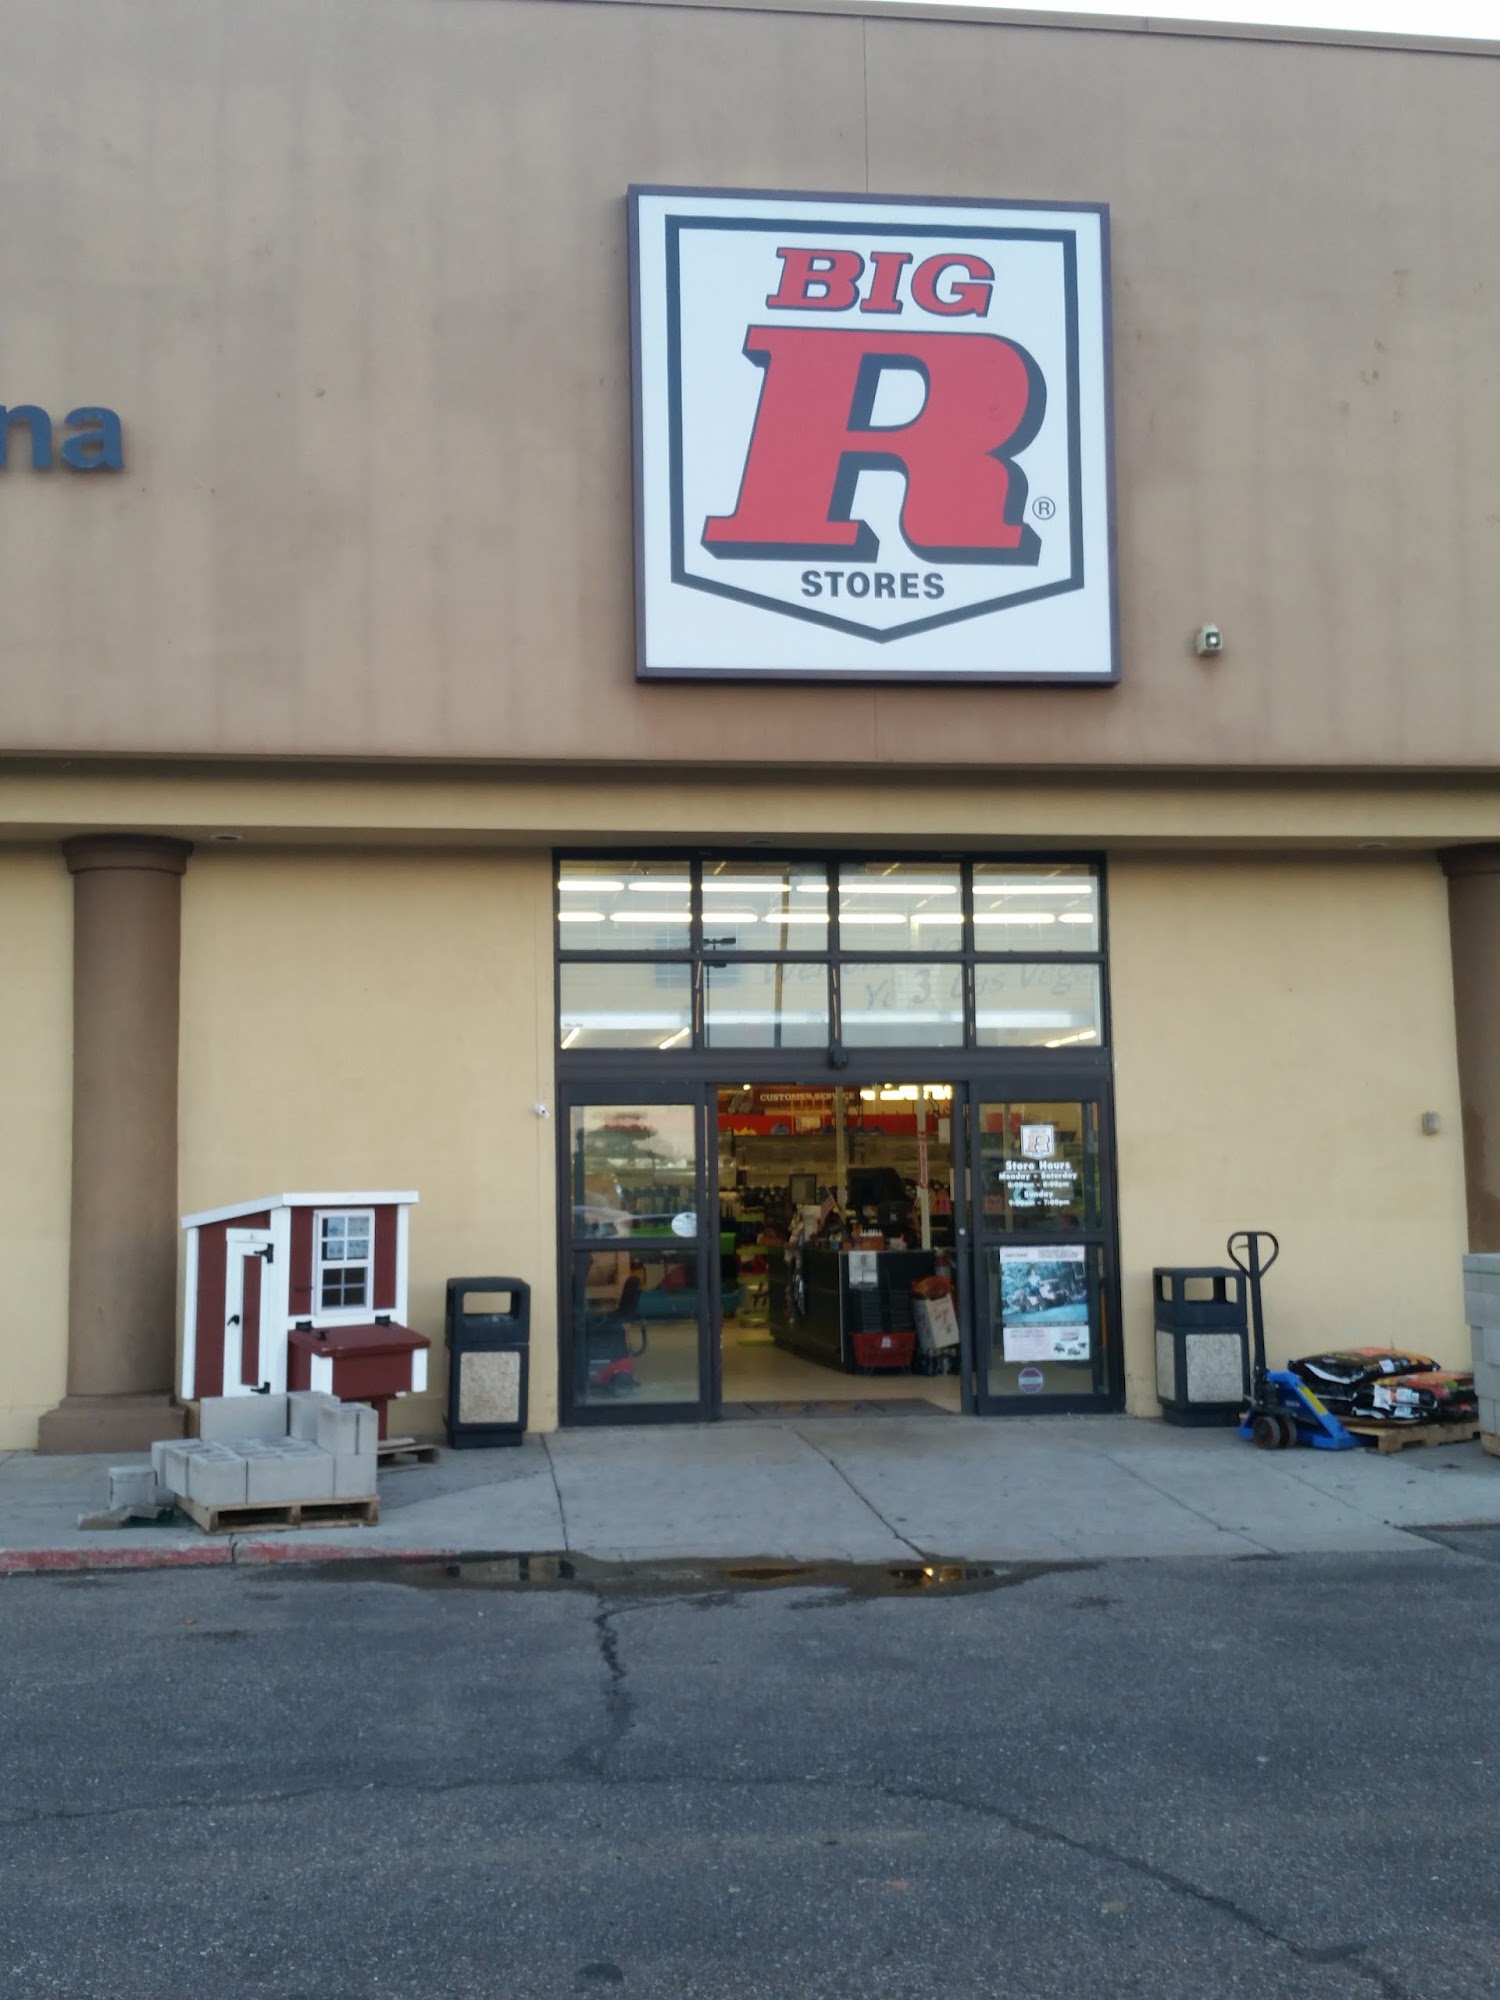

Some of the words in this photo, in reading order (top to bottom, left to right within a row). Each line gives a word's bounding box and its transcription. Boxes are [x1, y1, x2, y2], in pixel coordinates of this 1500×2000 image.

[765, 246, 996, 318] BIG
[700, 324, 1048, 567] R
[800, 570, 946, 600] STORES
[759, 1093, 812, 1101] CUSTOMER
[814, 1092, 855, 1100] SERVCE
[1005, 1160, 1035, 1171] Store
[1038, 1160, 1071, 1171] Hours
[998, 1172, 1030, 1181] Monday
[1041, 1171, 1078, 1181] Saturday
[1024, 1190, 1054, 1198] Sunday
